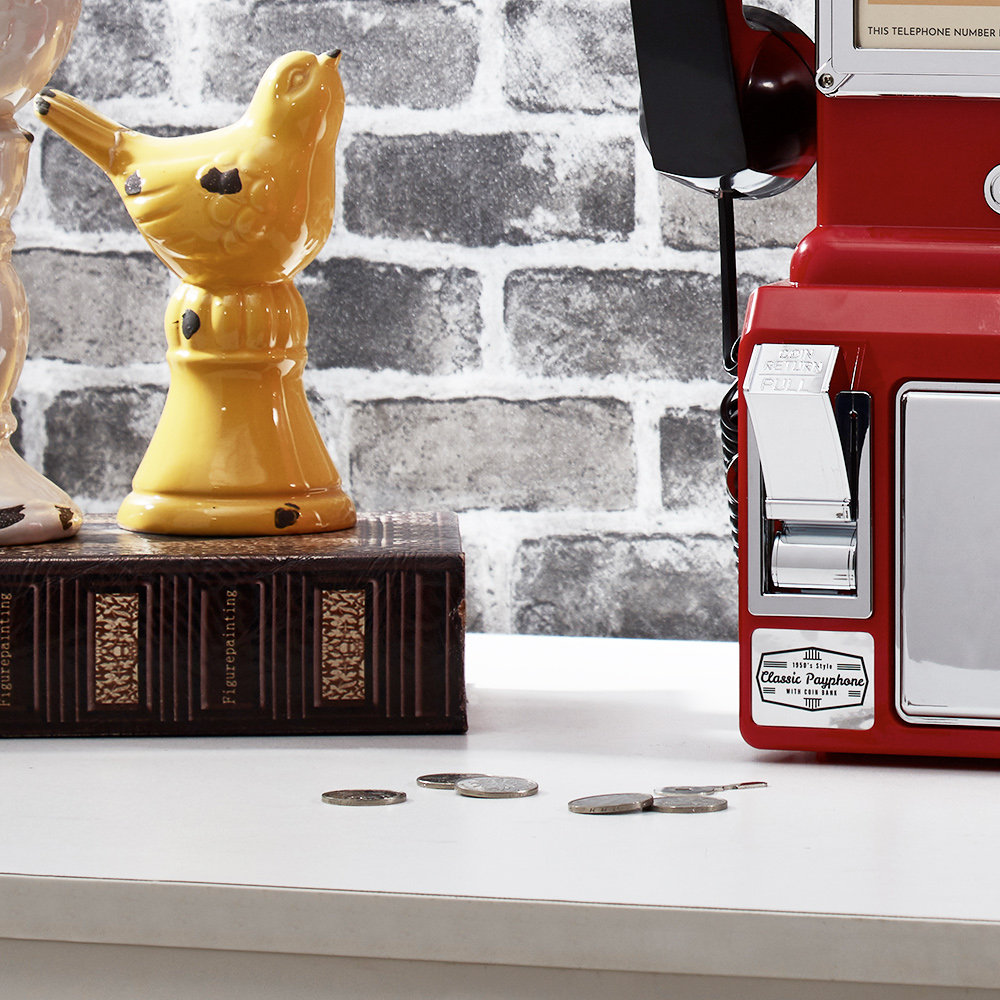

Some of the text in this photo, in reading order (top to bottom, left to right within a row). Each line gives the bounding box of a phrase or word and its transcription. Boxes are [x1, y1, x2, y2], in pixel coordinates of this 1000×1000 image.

[868, 27, 889, 35] THIS
[892, 27, 951, 36] TELEPHONE
[954, 28, 996, 37] NUMBER
[763, 360, 823, 373] RETURN
[761, 378, 809, 392] PULL
[222, 590, 237, 704] Figurepainting
[816, 663, 833, 671] Style
[761, 671, 865, 689] Classic Payphone
